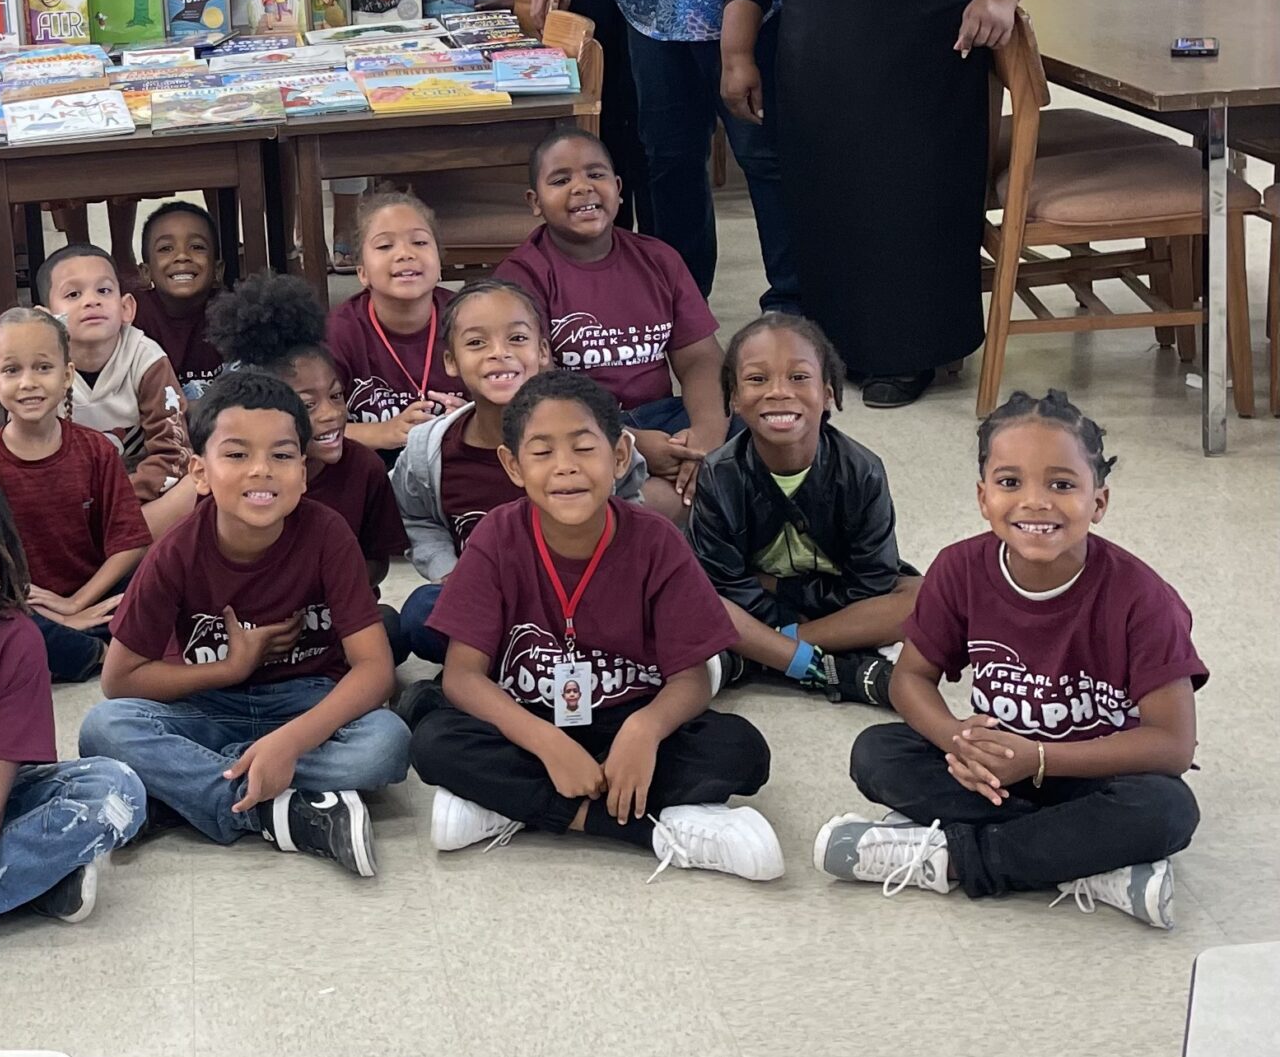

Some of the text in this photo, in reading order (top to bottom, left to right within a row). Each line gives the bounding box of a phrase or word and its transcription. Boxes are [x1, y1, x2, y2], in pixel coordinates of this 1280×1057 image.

[35, 11, 86, 41] AIR
[586, 327, 624, 338] PEARL
[582, 339, 606, 348] PRE
[610, 337, 620, 345] K
[997, 670, 1053, 687] PEARL
[990, 681, 1027, 696] PRE
[1033, 688, 1045, 699] K
